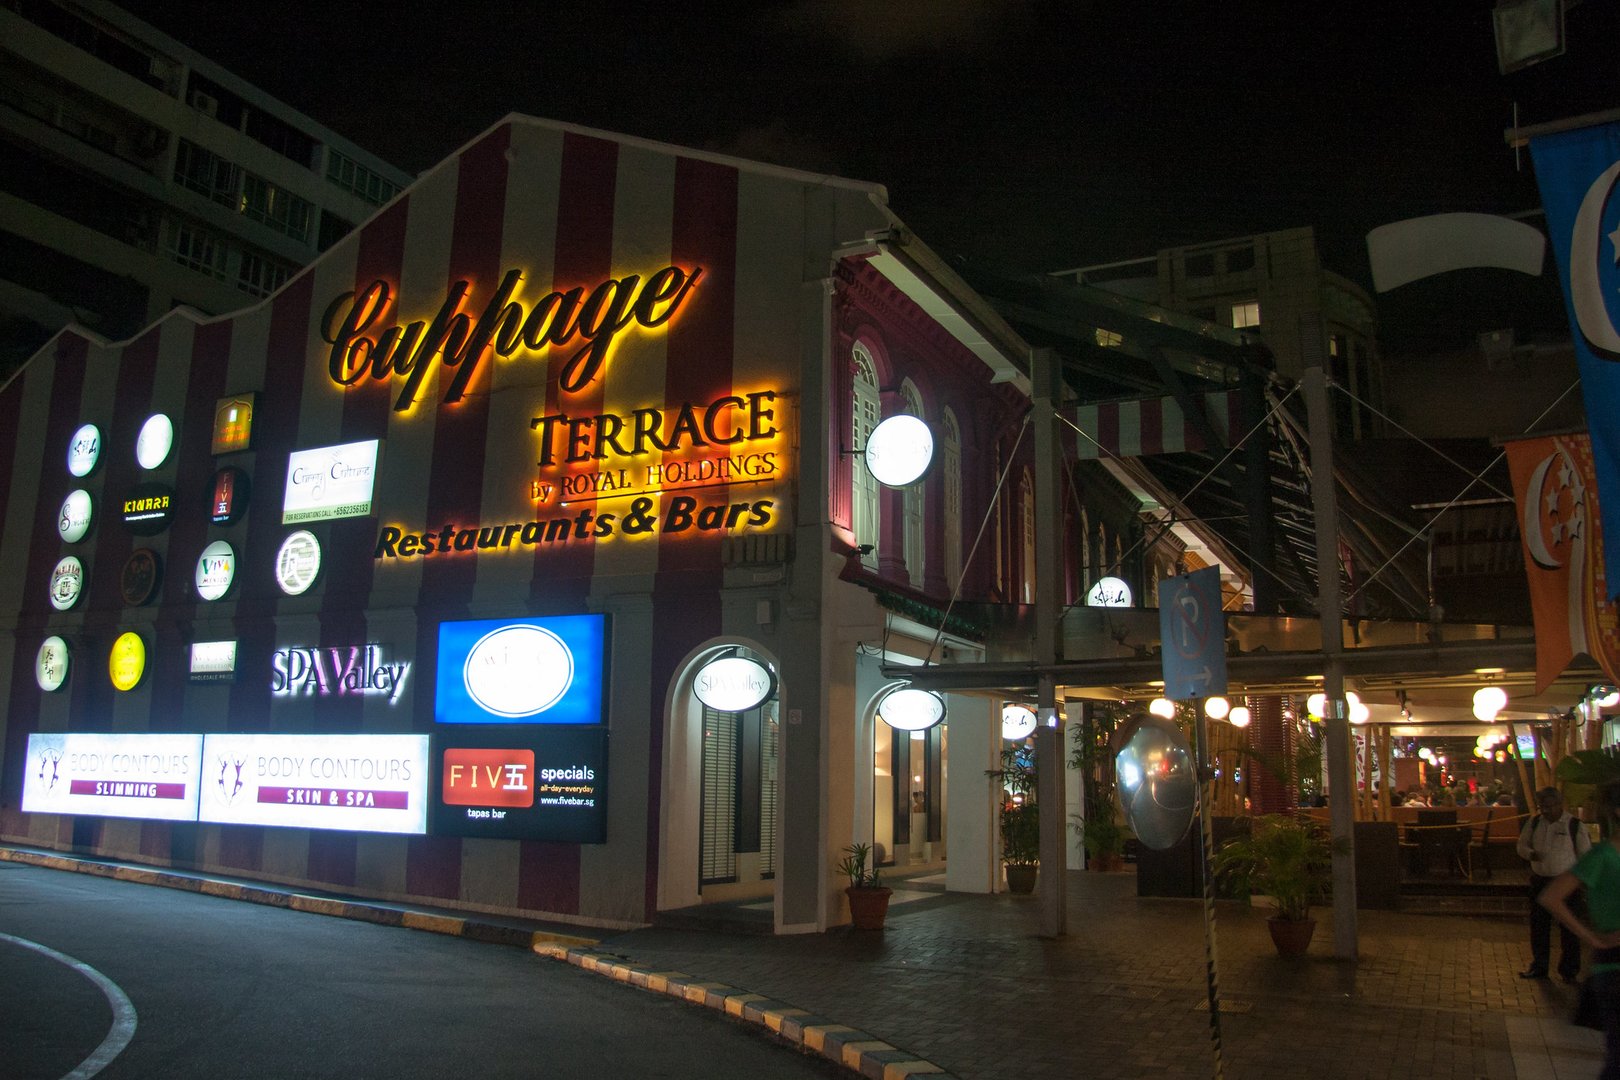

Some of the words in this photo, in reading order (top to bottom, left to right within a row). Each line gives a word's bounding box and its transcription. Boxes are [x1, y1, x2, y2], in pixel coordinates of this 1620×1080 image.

[320, 266, 703, 411] Cuppage
[531, 390, 777, 467] TERRACE
[531, 481, 552, 502] by
[560, 469, 631, 497] ROYAL
[646, 453, 776, 485] HOLDINGS
[124, 496, 169, 513] KINARA
[375, 509, 615, 558] Restaurants
[622, 497, 657, 534] &
[663, 496, 775, 533] Bars
[202, 558, 230, 575] VIVA
[71, 753, 107, 772] BODY
[111, 754, 190, 774] CONTOURS
[258, 757, 304, 777] BODY
[310, 757, 411, 781] CONTOURS
[541, 765, 595, 781] specials
[96, 782, 157, 797] SLIMMING
[286, 788, 322, 804] SKIN
[329, 790, 339, 805] &
[346, 791, 375, 806] SPA
[540, 797, 595, 807] www.fivebar.sg
[467, 808, 490, 819] tapas
[492, 808, 507, 818] bar
